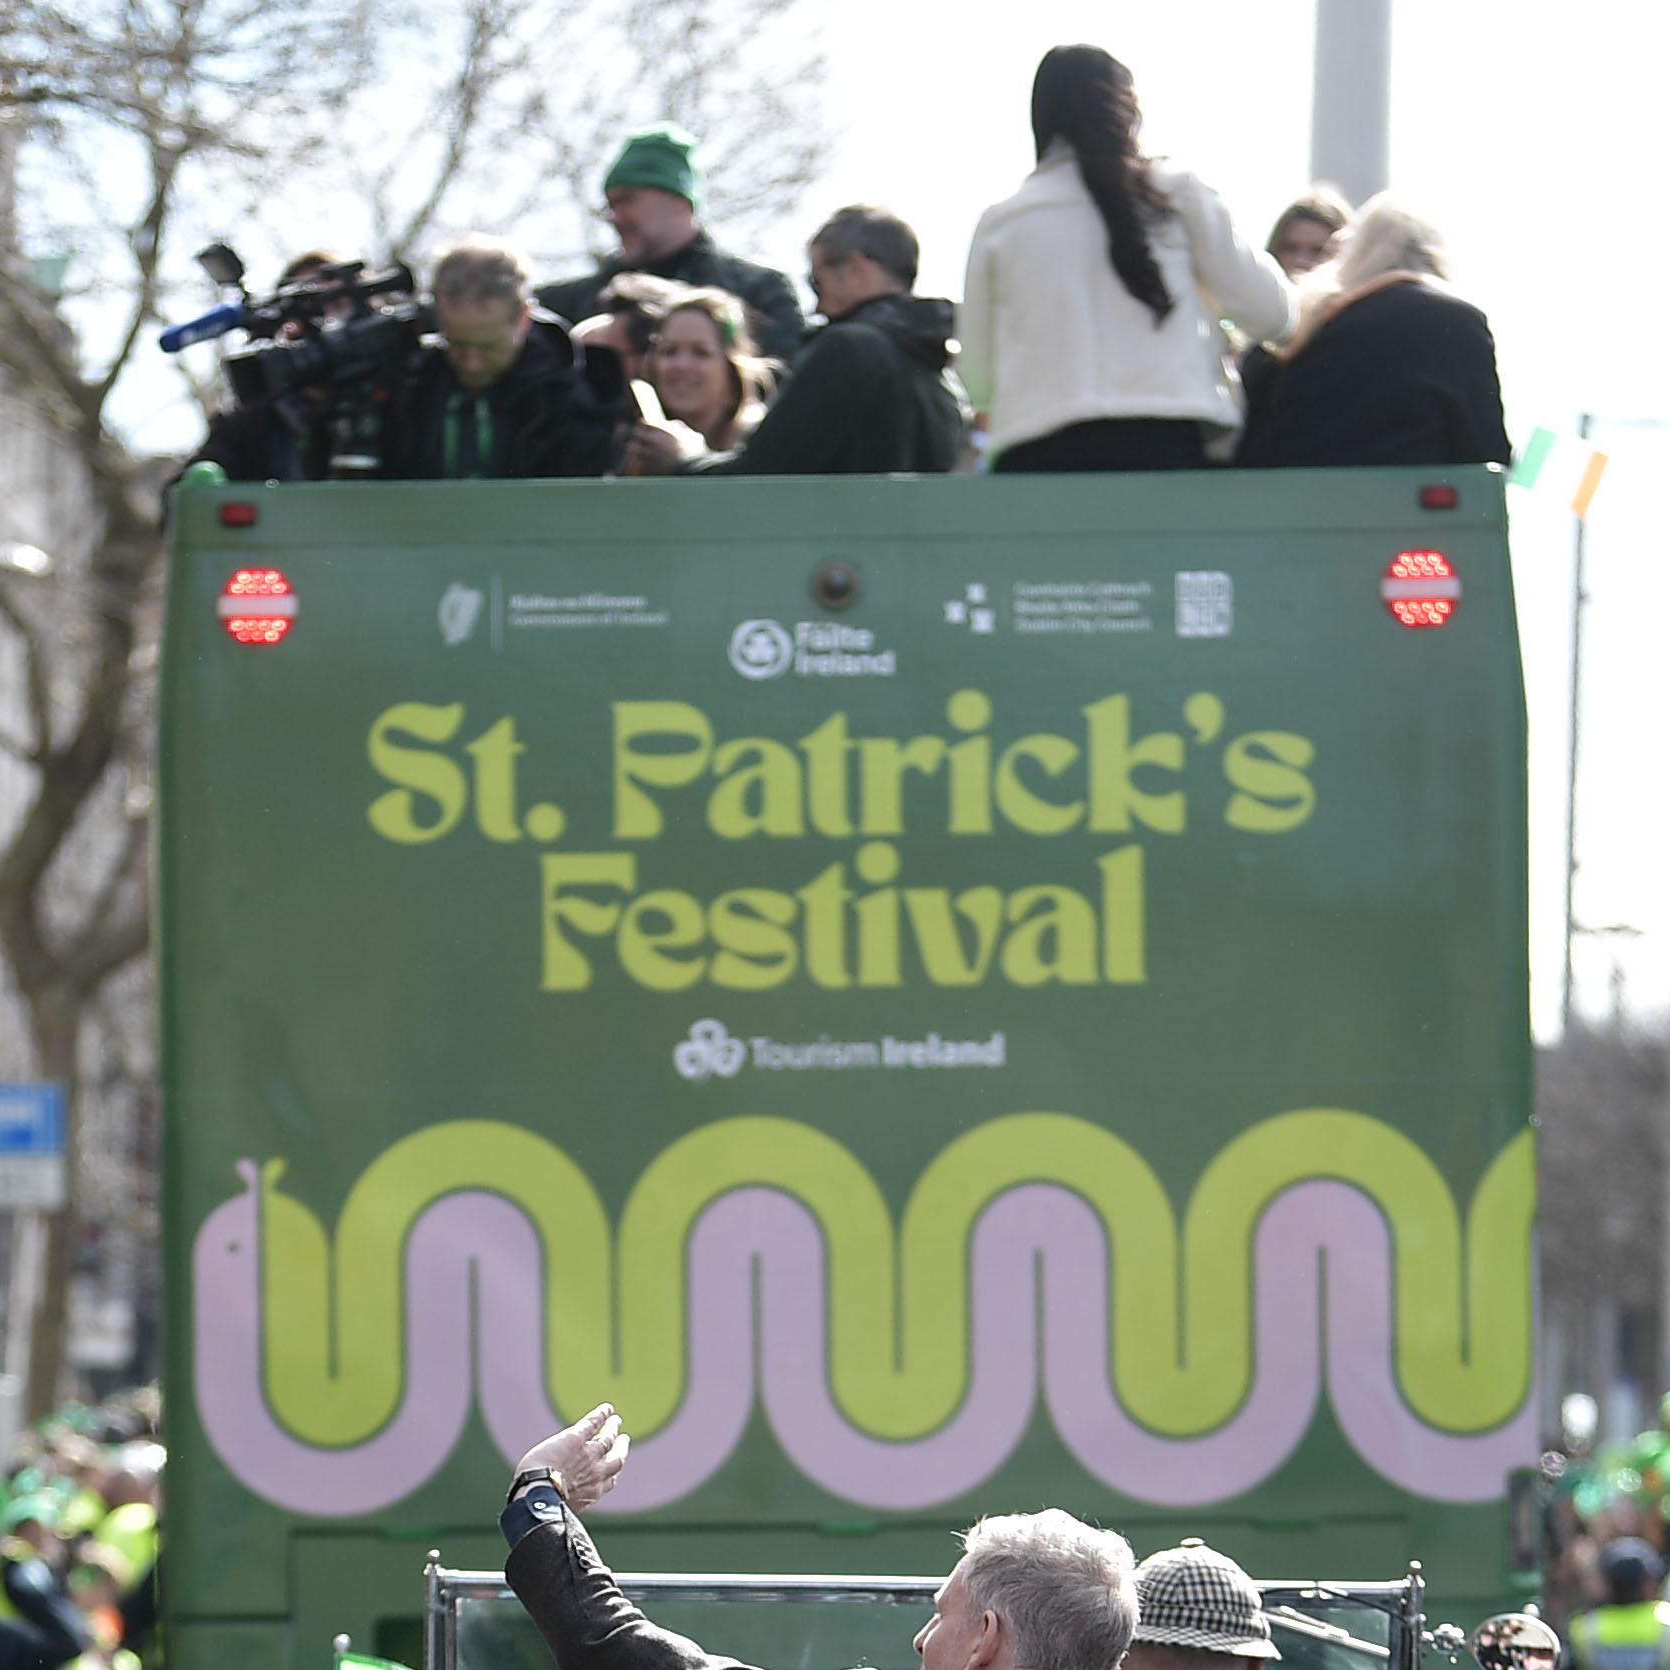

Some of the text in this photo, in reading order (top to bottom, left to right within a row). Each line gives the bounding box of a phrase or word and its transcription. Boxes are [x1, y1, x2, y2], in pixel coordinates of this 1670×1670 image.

[795, 649, 897, 676] Ireland
[368, 701, 566, 843] St.
[540, 842, 1145, 991] Festival
[753, 1032, 1006, 1069] Tourism Ireland
